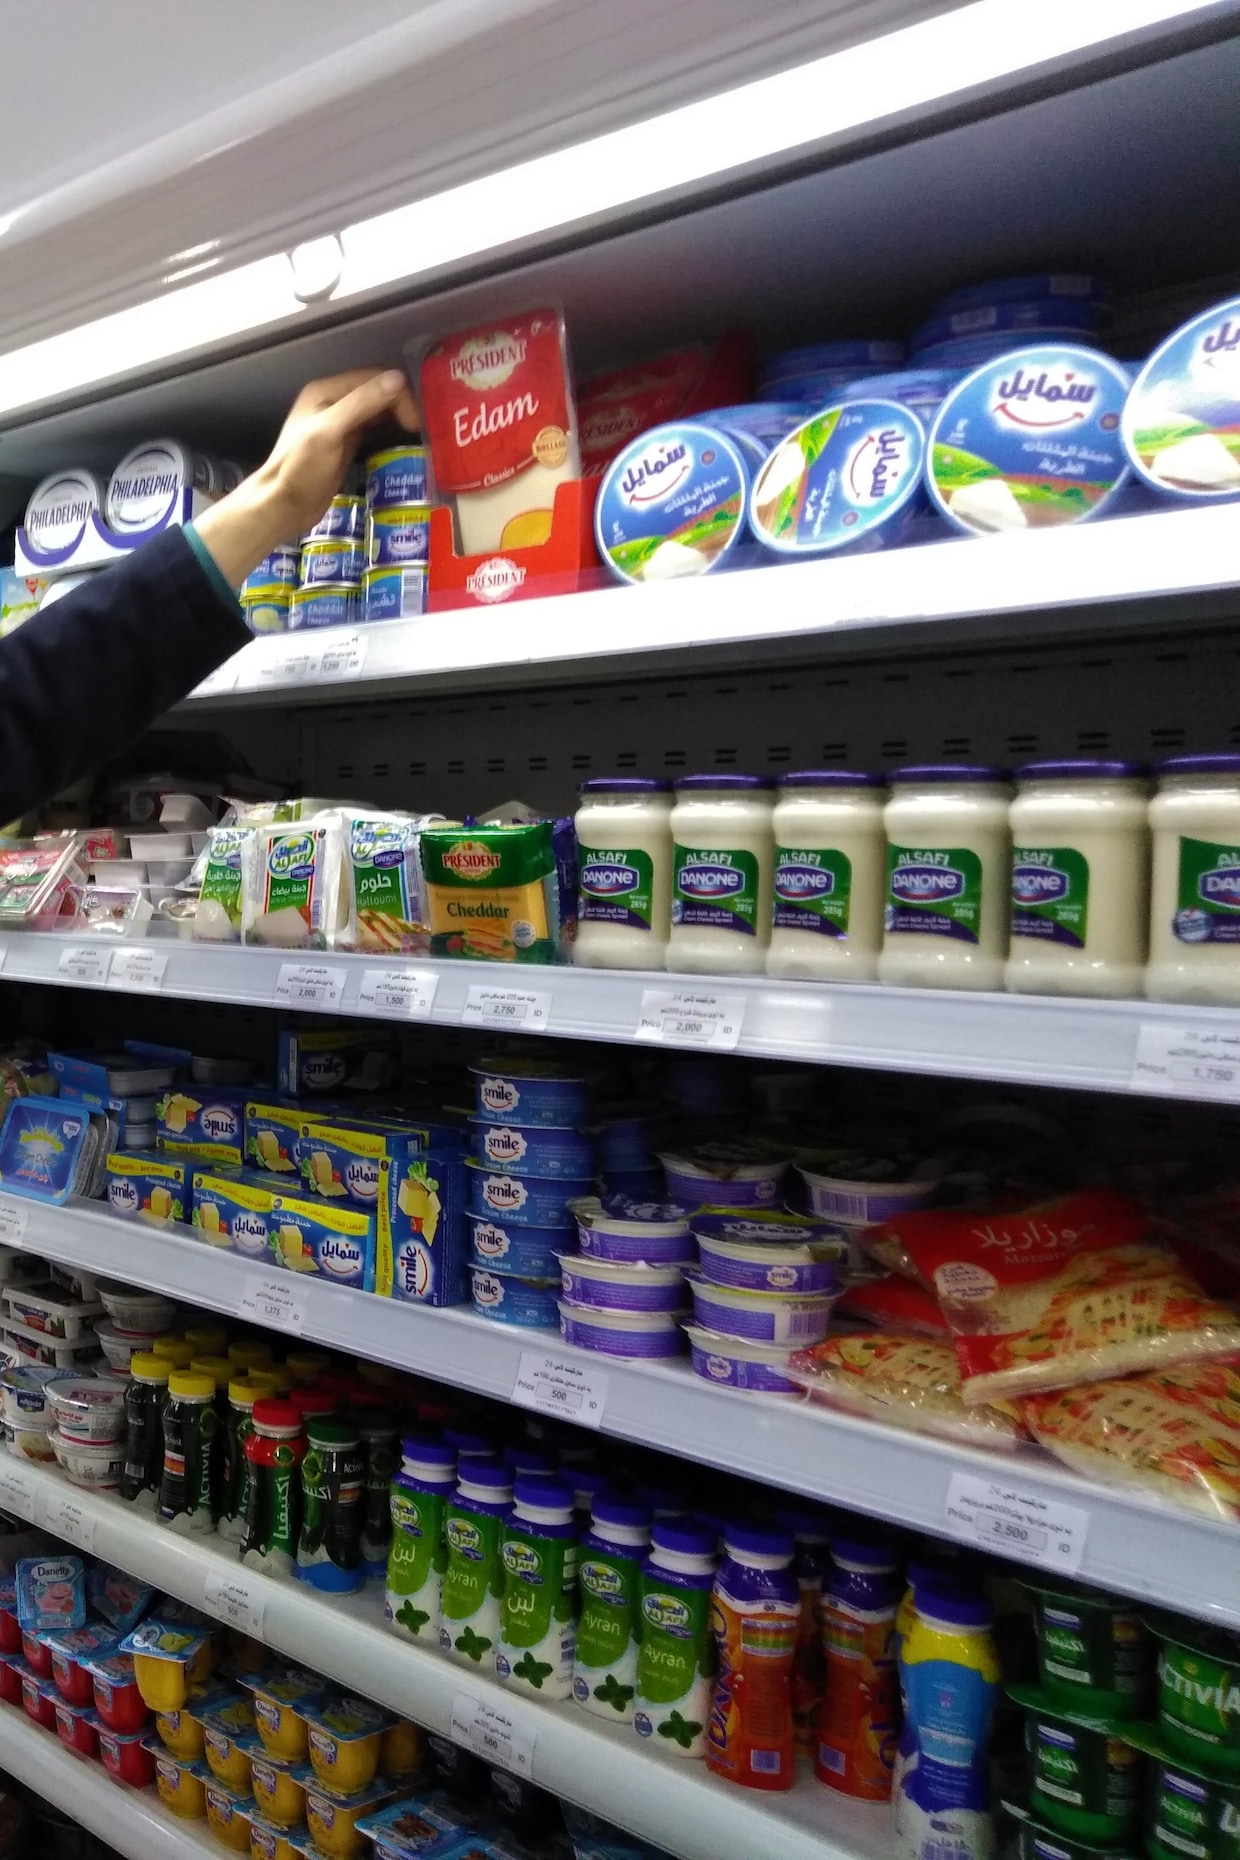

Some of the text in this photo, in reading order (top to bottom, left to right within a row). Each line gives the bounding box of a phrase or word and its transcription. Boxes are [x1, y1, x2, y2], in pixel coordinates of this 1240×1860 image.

[451, 342, 527, 378] PRÉSIDENT
[453, 392, 539, 448] Edam
[111, 473, 179, 500] PHILADELPHIA
[30, 501, 94, 533] PHILADELPHIA
[466, 567, 526, 588] PRÉSIDENT
[442, 850, 501, 869] PRÉSIDENT
[586, 852, 627, 865] ALSAFI
[686, 852, 732, 865] ALSAFI
[779, 852, 821, 866] ALSAFI
[898, 852, 950, 866] ALSAFI
[1013, 852, 1053, 866] LSAFI
[359, 873, 392, 894] حلوم
[583, 870, 634, 885] DANONE
[680, 872, 738, 887] DANONE
[776, 872, 828, 888] DANONE
[893, 874, 957, 889] DANONE
[447, 902, 510, 919] Cheddar
[493, 1005, 516, 1016] 2,750
[305, 1056, 342, 1075] smile
[483, 1085, 513, 1101] smile
[488, 1134, 519, 1151] smile
[111, 1182, 135, 1200] smile
[487, 1183, 520, 1199] smile
[235, 1218, 265, 1236] سمايل
[476, 1228, 504, 1247] smile
[321, 1240, 360, 1261] سمايل
[401, 1246, 417, 1294] smile
[474, 1278, 498, 1296] smile
[264, 1305, 281, 1316] 1,375
[517, 1380, 534, 1391] Price
[551, 1389, 567, 1401] 500
[198, 1441, 213, 1505] ACTIVIA
[392, 1543, 415, 1565] لبن
[508, 1592, 535, 1615] لبن
[583, 1609, 620, 1635] Ayran
[645, 1644, 686, 1670] Ayran
[483, 1735, 498, 1749] 500
